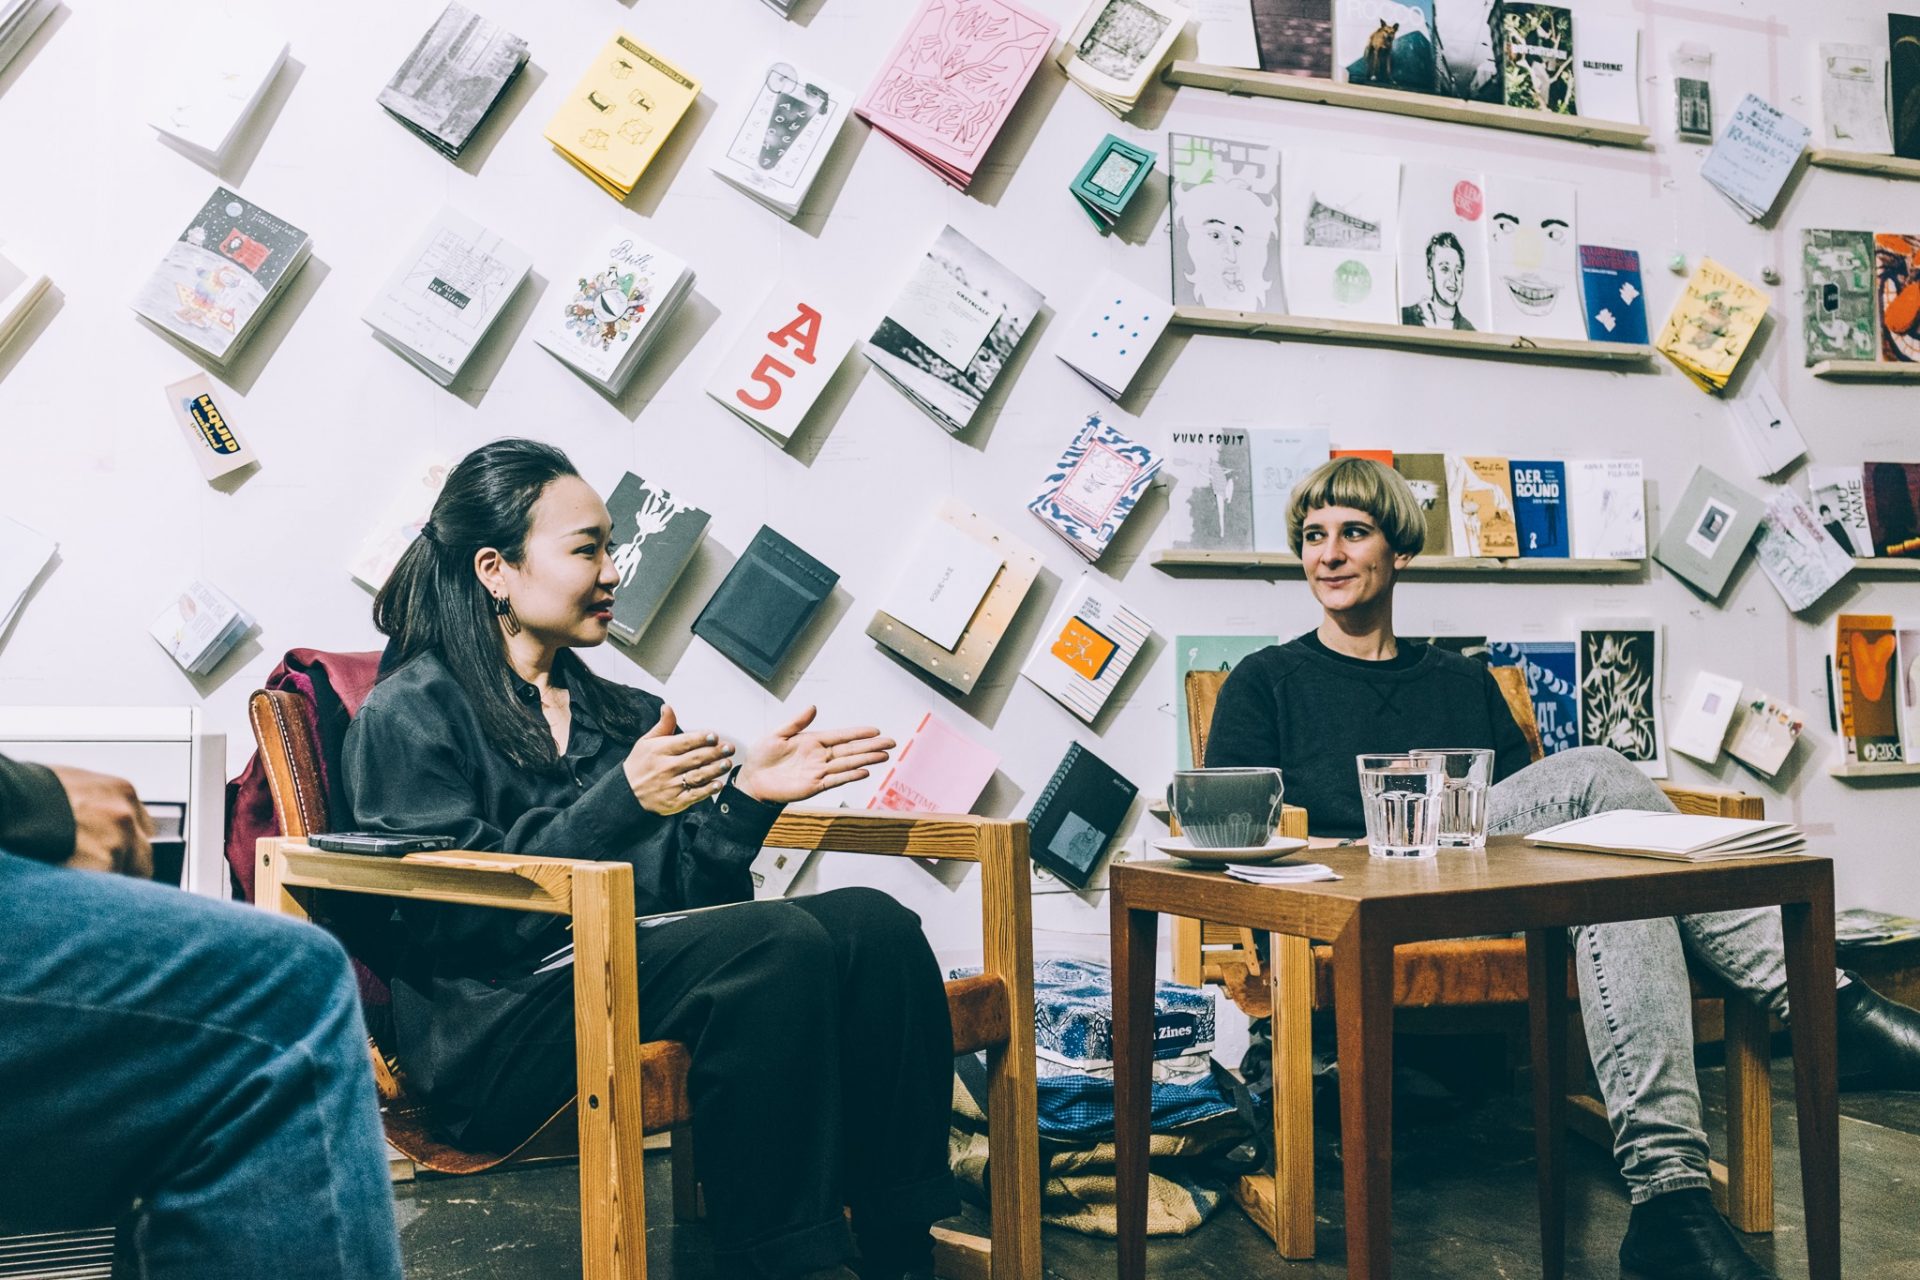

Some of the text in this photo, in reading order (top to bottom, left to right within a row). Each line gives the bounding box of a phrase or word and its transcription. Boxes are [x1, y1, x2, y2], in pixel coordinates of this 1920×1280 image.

[768, 302, 825, 365] A
[736, 353, 797, 411] 5
[198, 395, 238, 452] LIQUID
[1514, 469, 1543, 484] DER
[1516, 483, 1560, 498] ROUND
[1848, 479, 1867, 529] NAME
[1158, 1025, 1192, 1040] Zines
